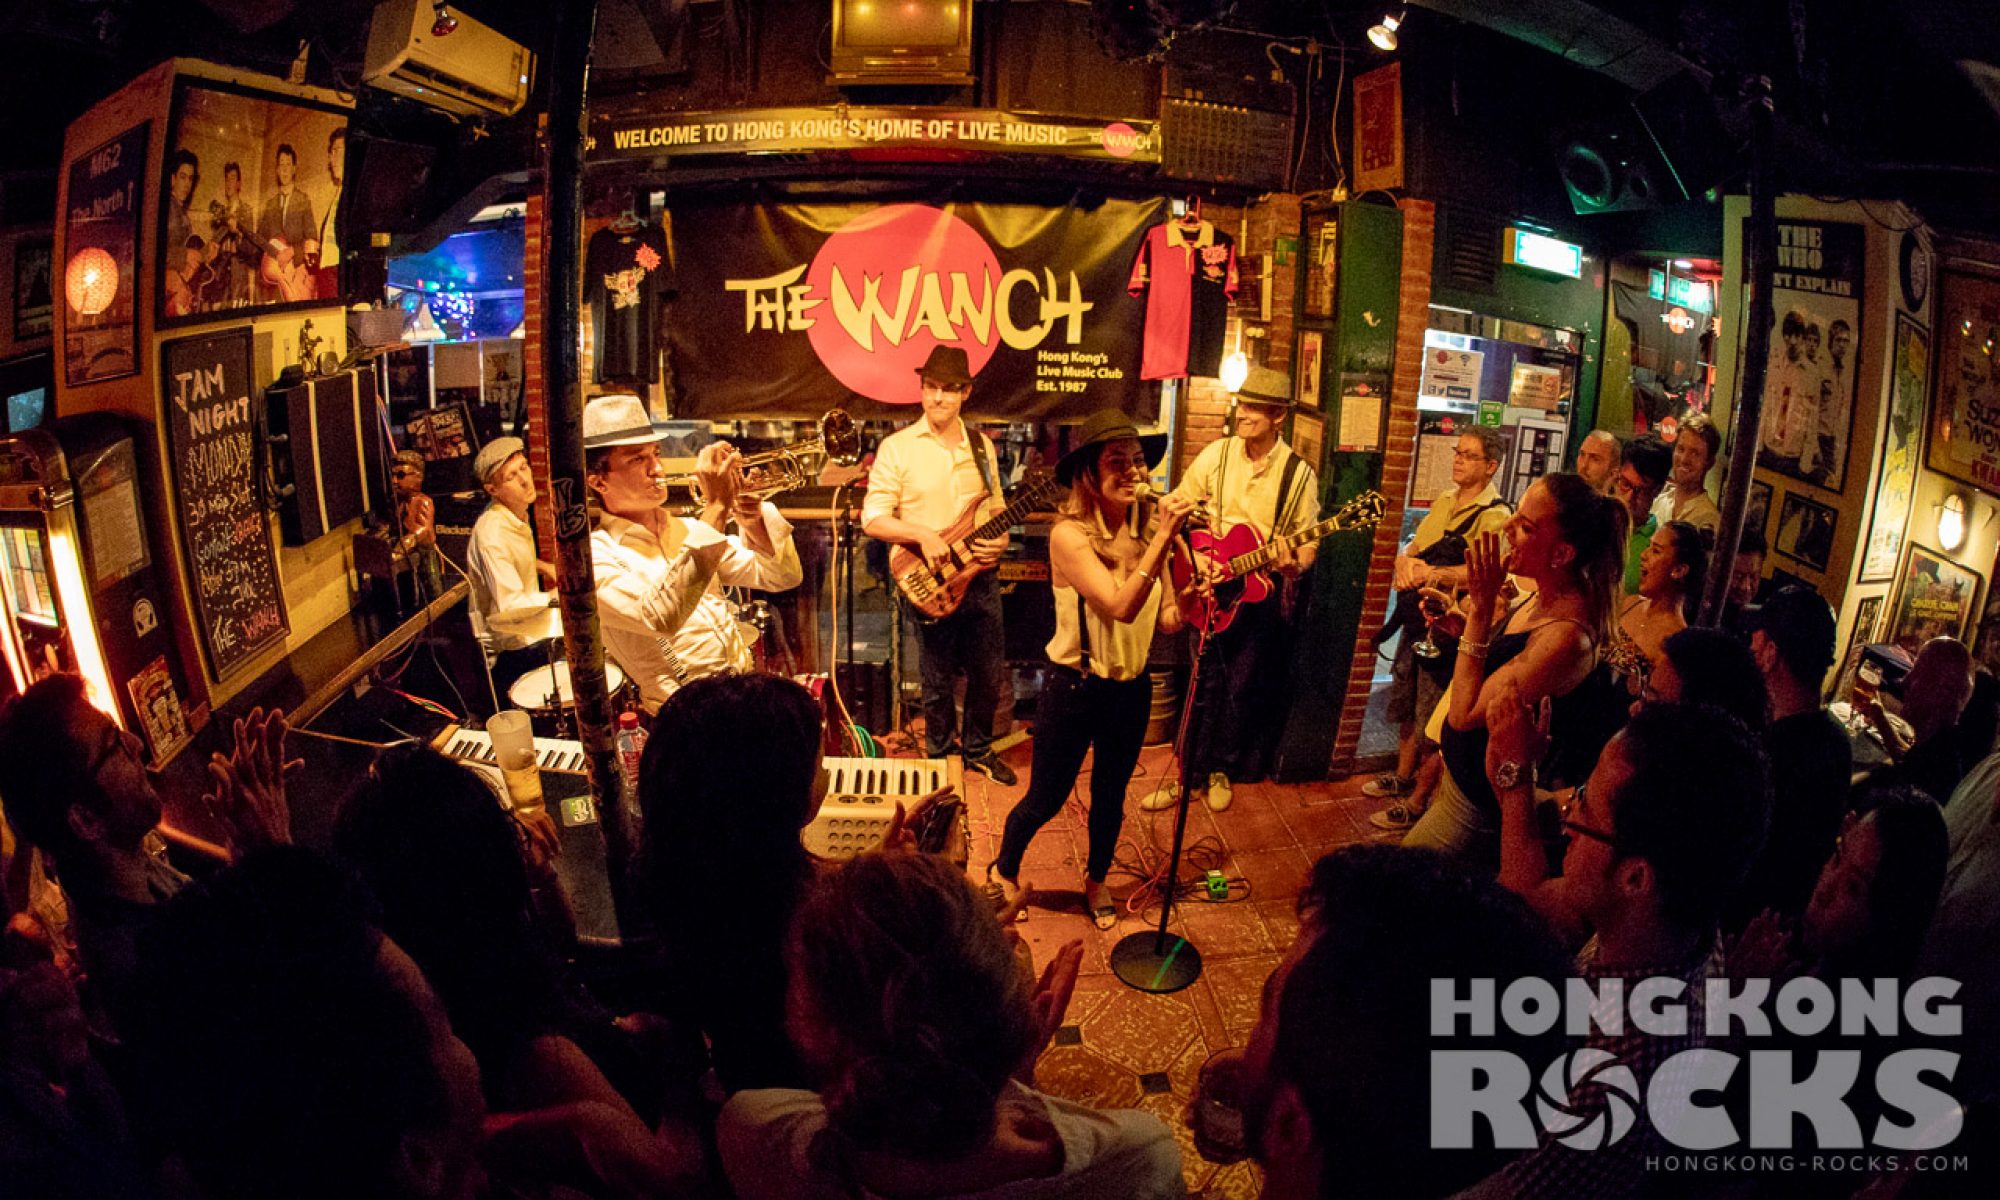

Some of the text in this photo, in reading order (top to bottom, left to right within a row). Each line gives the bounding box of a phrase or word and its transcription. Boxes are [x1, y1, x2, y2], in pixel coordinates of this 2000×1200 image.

[614, 124, 700, 150] WELCOME
[705, 123, 727, 142] TO
[733, 121, 784, 142] HONG
[790, 119, 861, 138] KONG'S
[866, 119, 922, 139] HOME
[927, 119, 954, 139] OF
[958, 121, 1000, 141] LIVE
[1005, 123, 1068, 145] MUSIC
[1777, 224, 1822, 249] THE
[1777, 245, 1823, 271] WHO
[725, 262, 1094, 353] THE WANCH
[1037, 364, 1124, 379] Live Music Club
[1038, 350, 1108, 366] Hong Kong's
[174, 363, 225, 412] JAM
[1036, 379, 1088, 393] Est. 1987
[188, 396, 250, 439] NIGHT
[212, 613, 237, 654] THE
